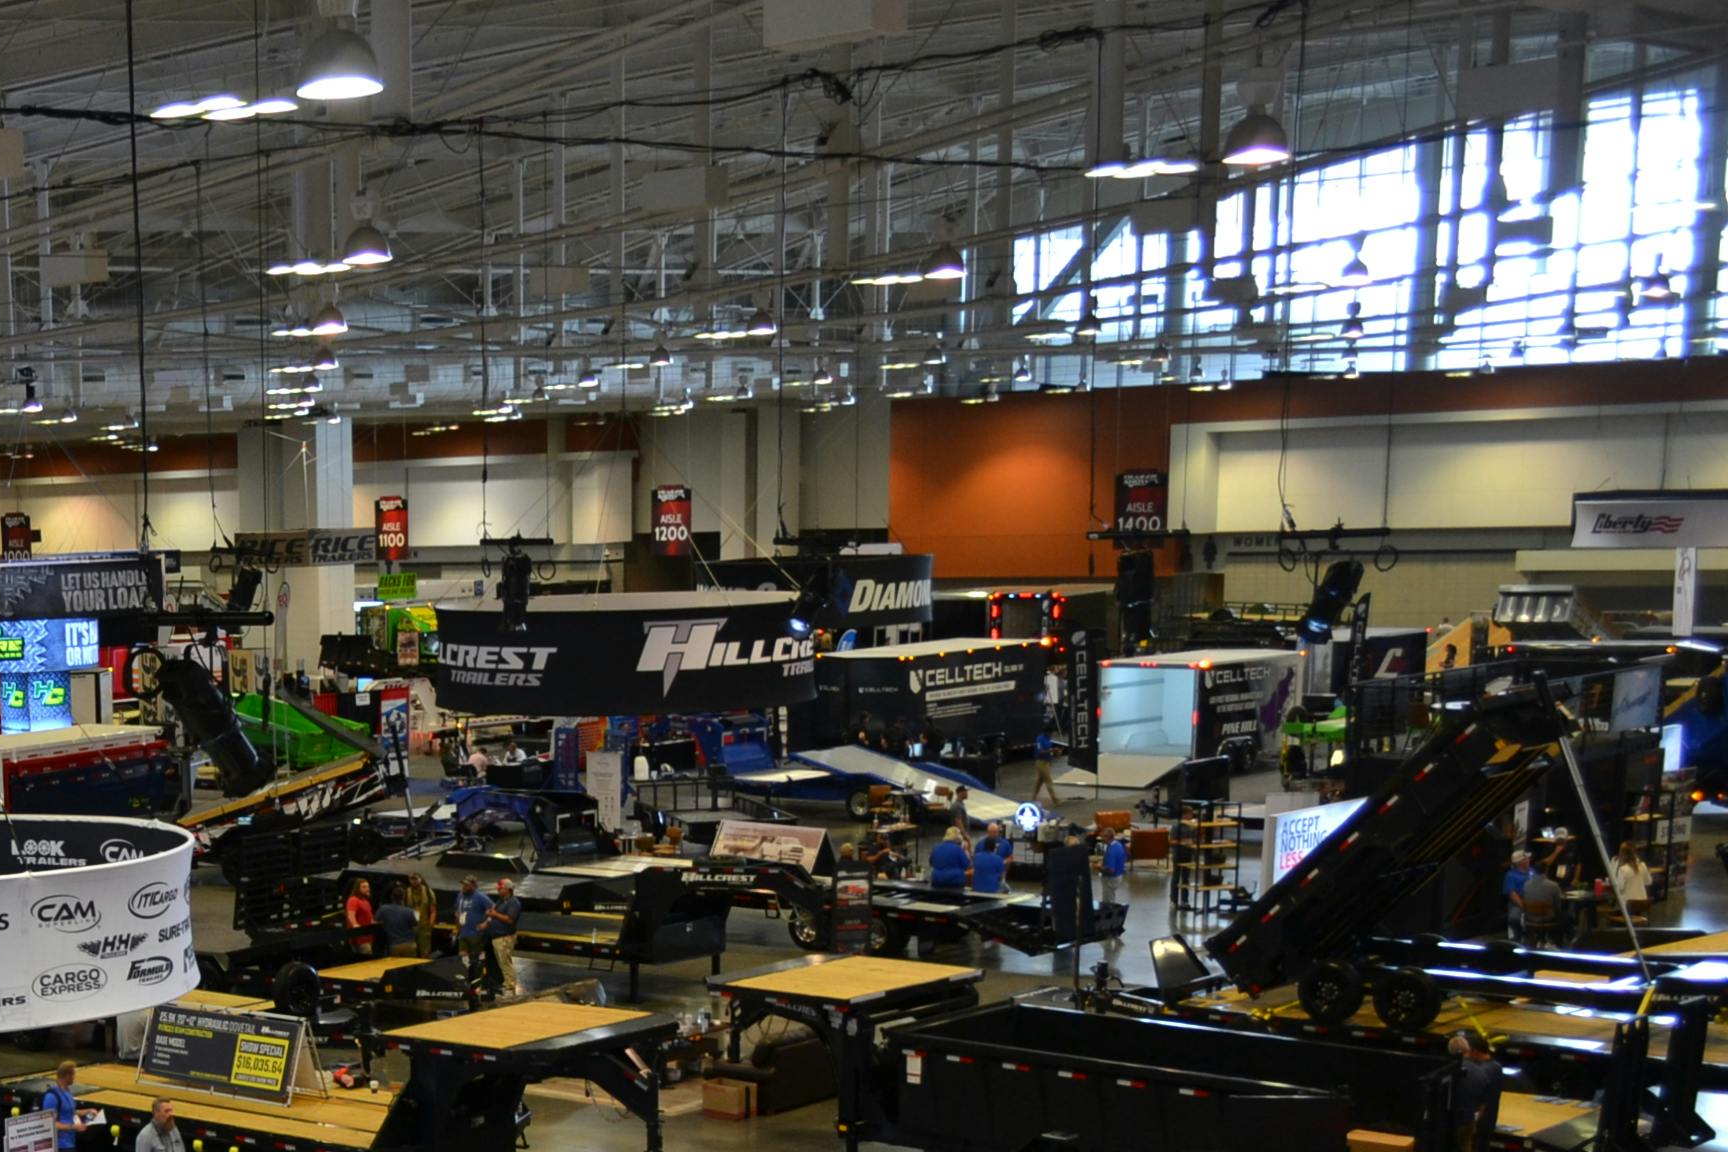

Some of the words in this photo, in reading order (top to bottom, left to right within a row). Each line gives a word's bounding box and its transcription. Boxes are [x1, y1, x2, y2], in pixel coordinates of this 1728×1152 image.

[1126, 502, 1154, 513] AISLE
[382, 522, 401, 531] AISLE
[660, 514, 682, 524] AISLE
[378, 534, 405, 548] 1100
[654, 527, 687, 542] 1200
[312, 535, 374, 555] RICE
[311, 551, 374, 564] TRAILERS
[61, 573, 80, 591] LET
[83, 572, 99, 590] US
[62, 591, 107, 613] YOUR
[450, 670, 544, 687] TRAILERS
[925, 661, 1003, 687] CELLTECH
[1215, 666, 1272, 685] CELLTECH
[1075, 650, 1089, 749] CELLTECH
[1281, 816, 1322, 836] ACCEPT
[11, 839, 66, 857] LOOK
[681, 871, 757, 883] HILLCREST
[37, 900, 95, 922] CAM
[39, 969, 101, 988] CARGO
[40, 981, 101, 997] EXPRESS
[240, 1041, 259, 1054] SHOW
[259, 1044, 283, 1057] SPECIAL
